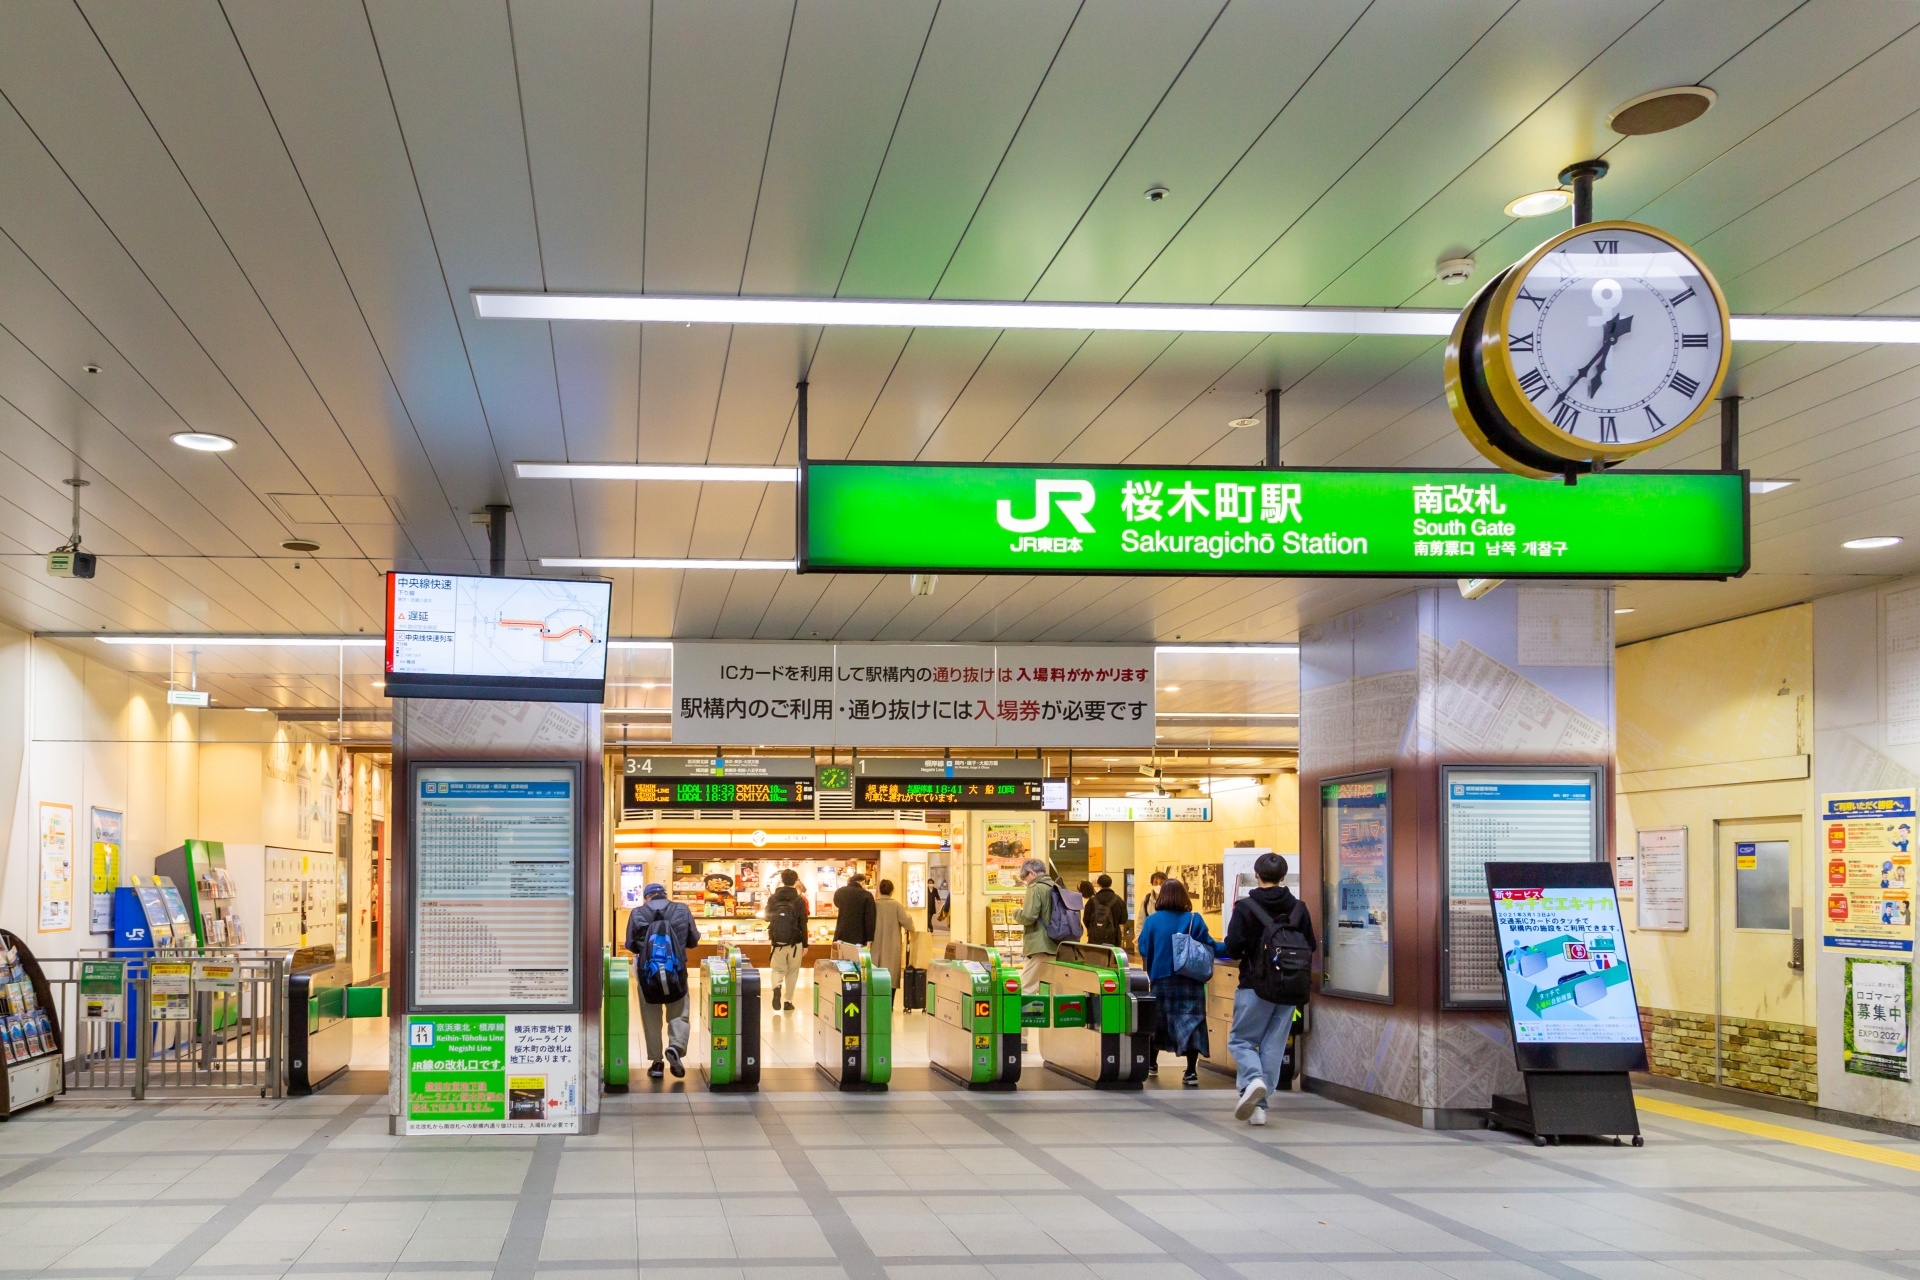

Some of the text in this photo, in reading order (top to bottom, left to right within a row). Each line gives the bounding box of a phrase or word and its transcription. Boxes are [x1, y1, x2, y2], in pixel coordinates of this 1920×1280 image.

[1120, 480, 1303, 524] 桜木町駅
[1412, 484, 1507, 515] 南改札
[996, 479, 1096, 533] JR
[1413, 518, 1515, 536] South Gate
[1010, 537, 1083, 553] JR東日本
[1121, 529, 1368, 559] Sakuragichō Station
[1413, 541, 1568, 556] 南剪票口 남쪽 개찰구
[398, 578, 452, 590] 中央線快速
[408, 611, 429, 621] 遅延
[680, 697, 1148, 721] 駅構内のご利用・通り抜けには入場券が必要です
[677, 784, 702, 793] LOCAL
[705, 784, 735, 793] 18:33
[795, 785, 802, 793] 3
[934, 784, 963, 794] 18:41
[1024, 785, 1030, 795] 1
[677, 793, 702, 801] LOCAL
[705, 793, 735, 801] 18:37
[795, 794, 802, 802] 4
[1059, 838, 1066, 848] 2
[1495, 890, 1541, 899] 新サービス
[1501, 897, 1614, 911] タッチでエキナカ
[126, 928, 145, 938] JR
[1857, 991, 1902, 1003] ロゴマーク
[714, 1003, 728, 1017] IC
[975, 1003, 990, 1016] IC
[1857, 1002, 1902, 1022] 募集中
[436, 1023, 504, 1032] 京浜東北・根岸線
[514, 1025, 572, 1033] 横浜市営地下鉄
[415, 1034, 428, 1043] 11
[1858, 1029, 1901, 1041] EXPO 2027
[448, 1045, 475, 1053] Negishi
[514, 1045, 572, 1053] 桜木町の改札は
[509, 1055, 572, 1064] 地下にあります。
[412, 1060, 506, 1071] JR線の改札口です。
